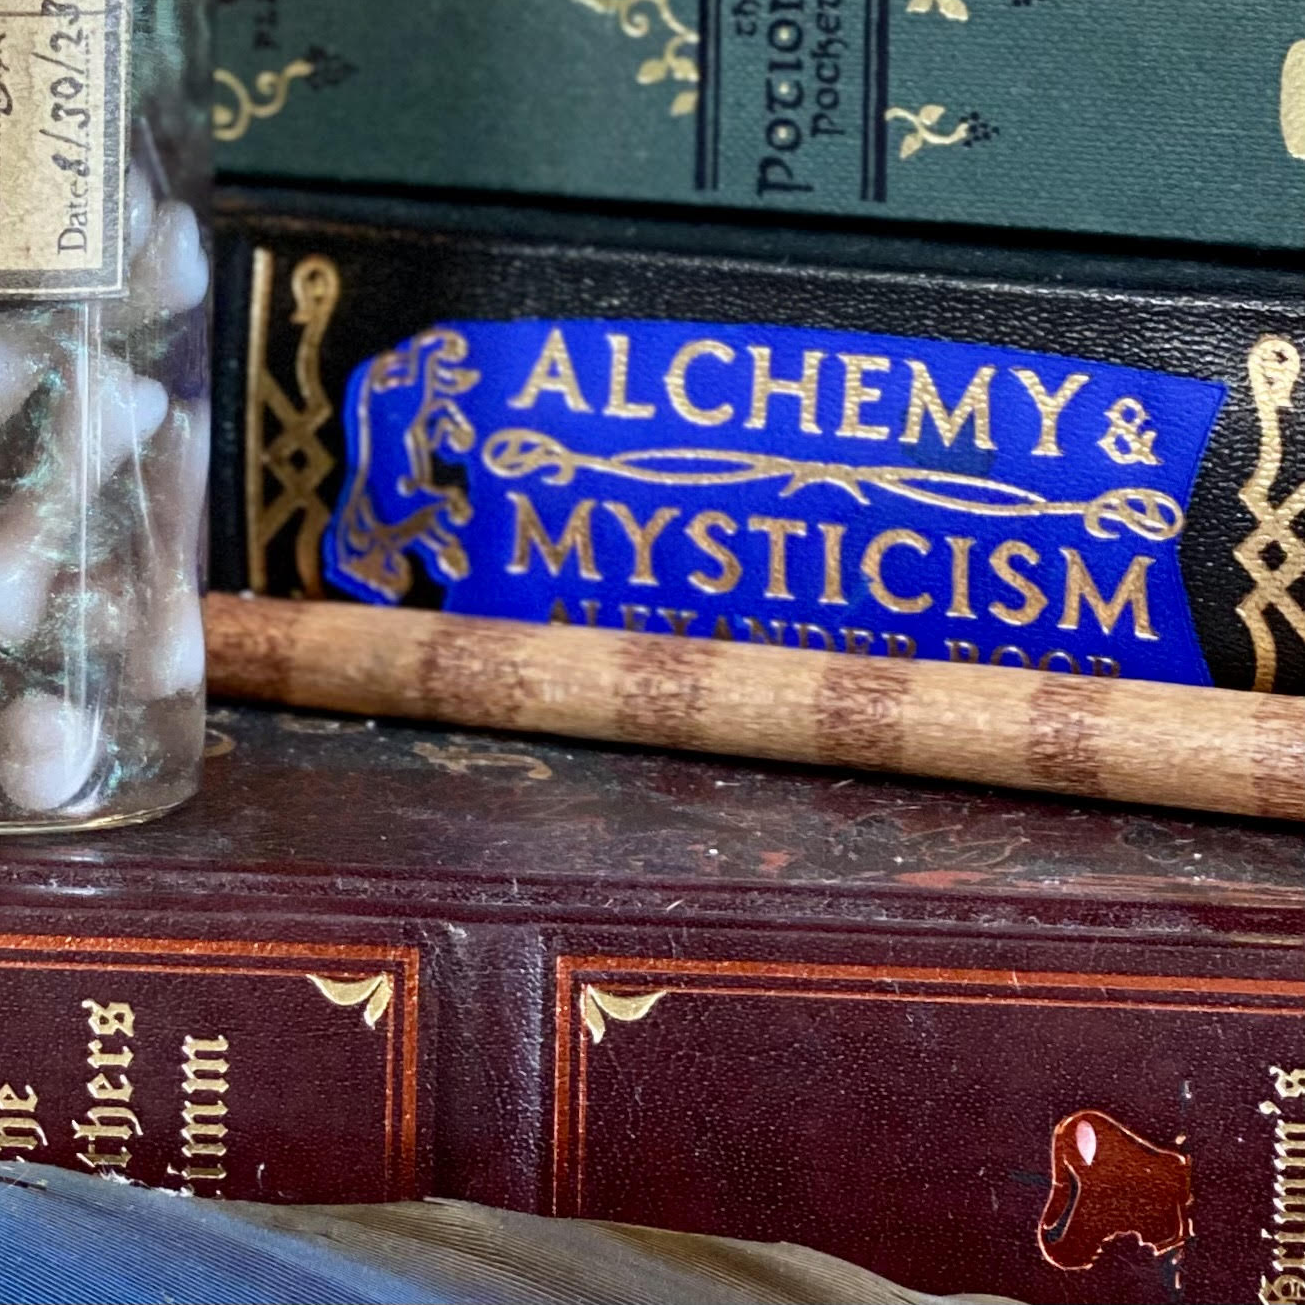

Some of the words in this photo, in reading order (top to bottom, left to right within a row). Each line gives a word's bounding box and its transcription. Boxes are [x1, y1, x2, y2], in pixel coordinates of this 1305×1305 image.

[508, 326, 1090, 457] ALCHEMY
[1097, 396, 1164, 467] &
[506, 491, 1160, 641] MYSTICISM
